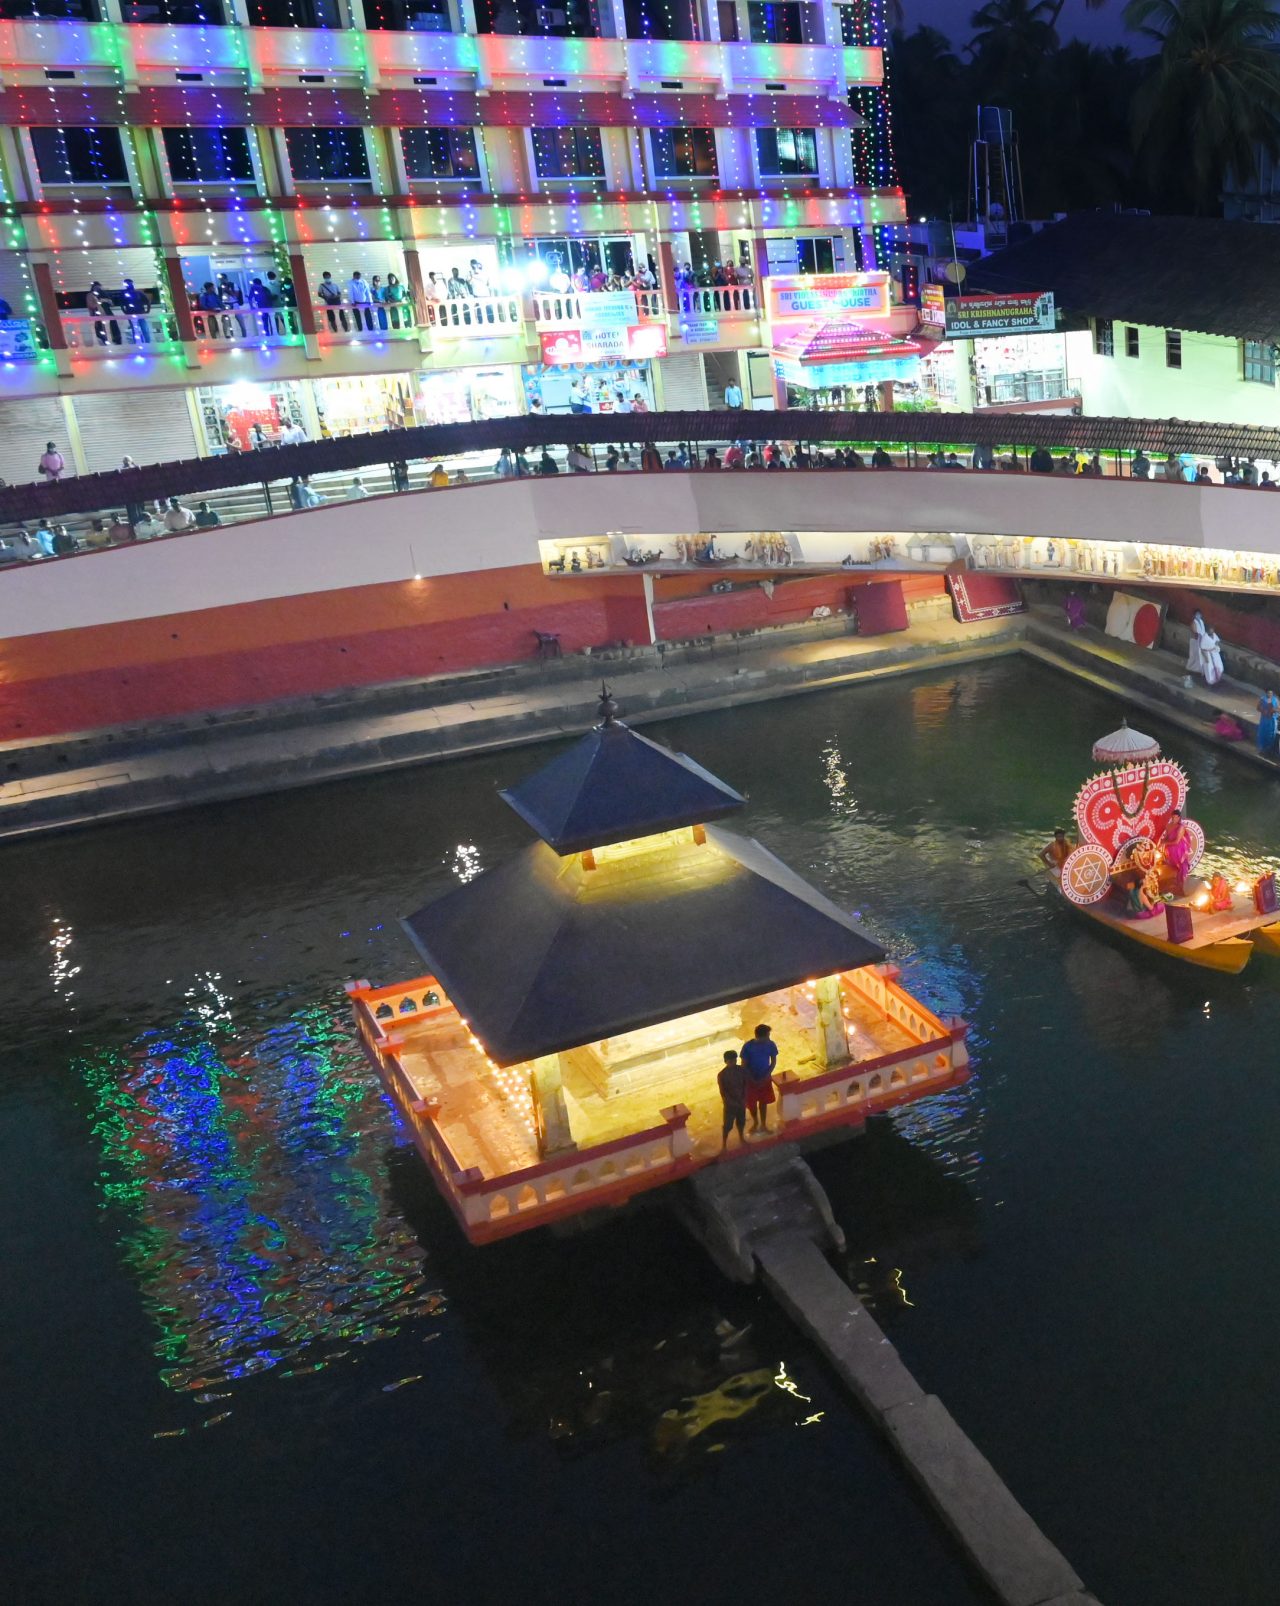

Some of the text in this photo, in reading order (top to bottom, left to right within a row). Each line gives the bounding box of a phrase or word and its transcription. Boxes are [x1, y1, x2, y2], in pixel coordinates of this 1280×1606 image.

[958, 307, 1033, 319] SRI KRISHNANUGRAHA
[951, 321, 971, 330] IDOL
[973, 320, 980, 328] &
[982, 318, 1009, 328] FANCY
[1011, 317, 1034, 326] SHOP
